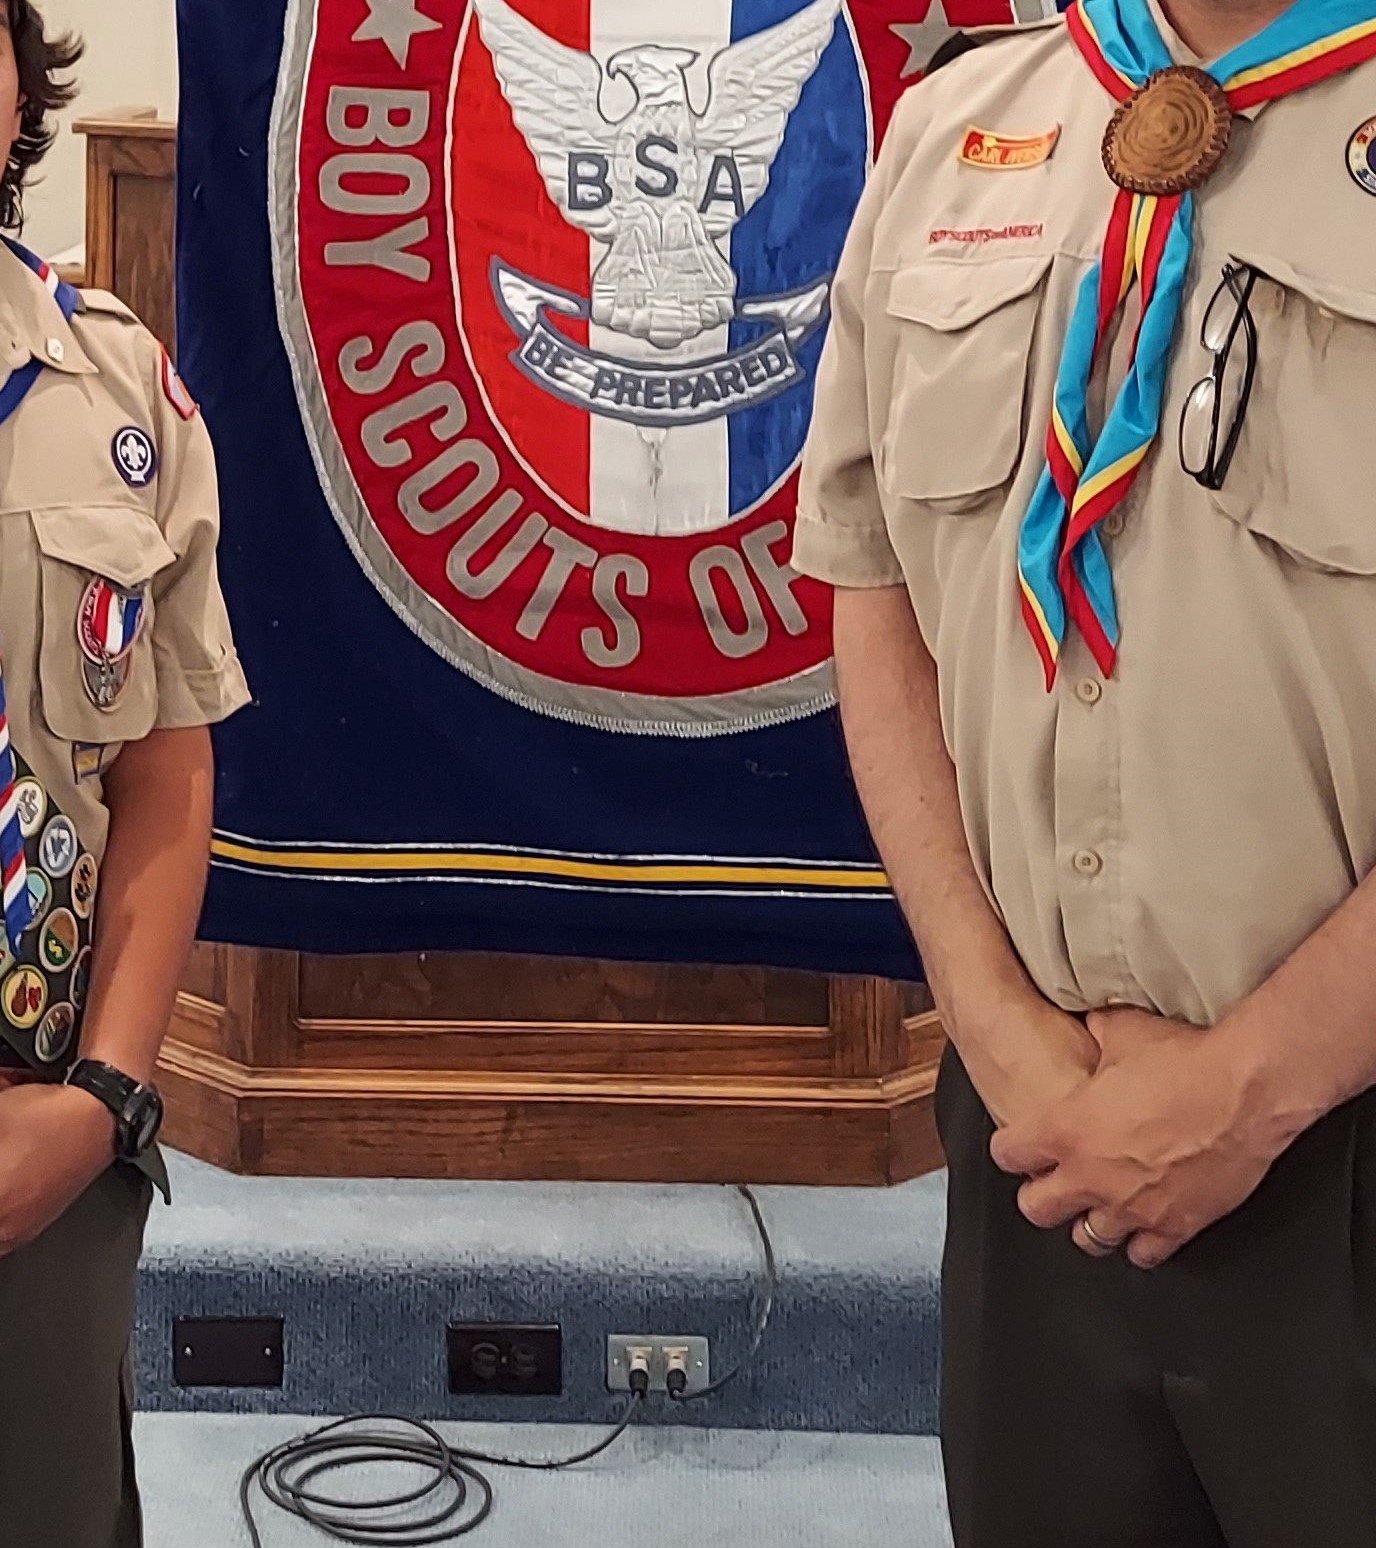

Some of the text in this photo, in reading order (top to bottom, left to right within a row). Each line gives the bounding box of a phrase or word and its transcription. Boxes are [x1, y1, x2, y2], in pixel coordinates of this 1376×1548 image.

[318, 85, 809, 668] BOY SCOUTS OF
[525, 335, 789, 409] BE PREPARED
